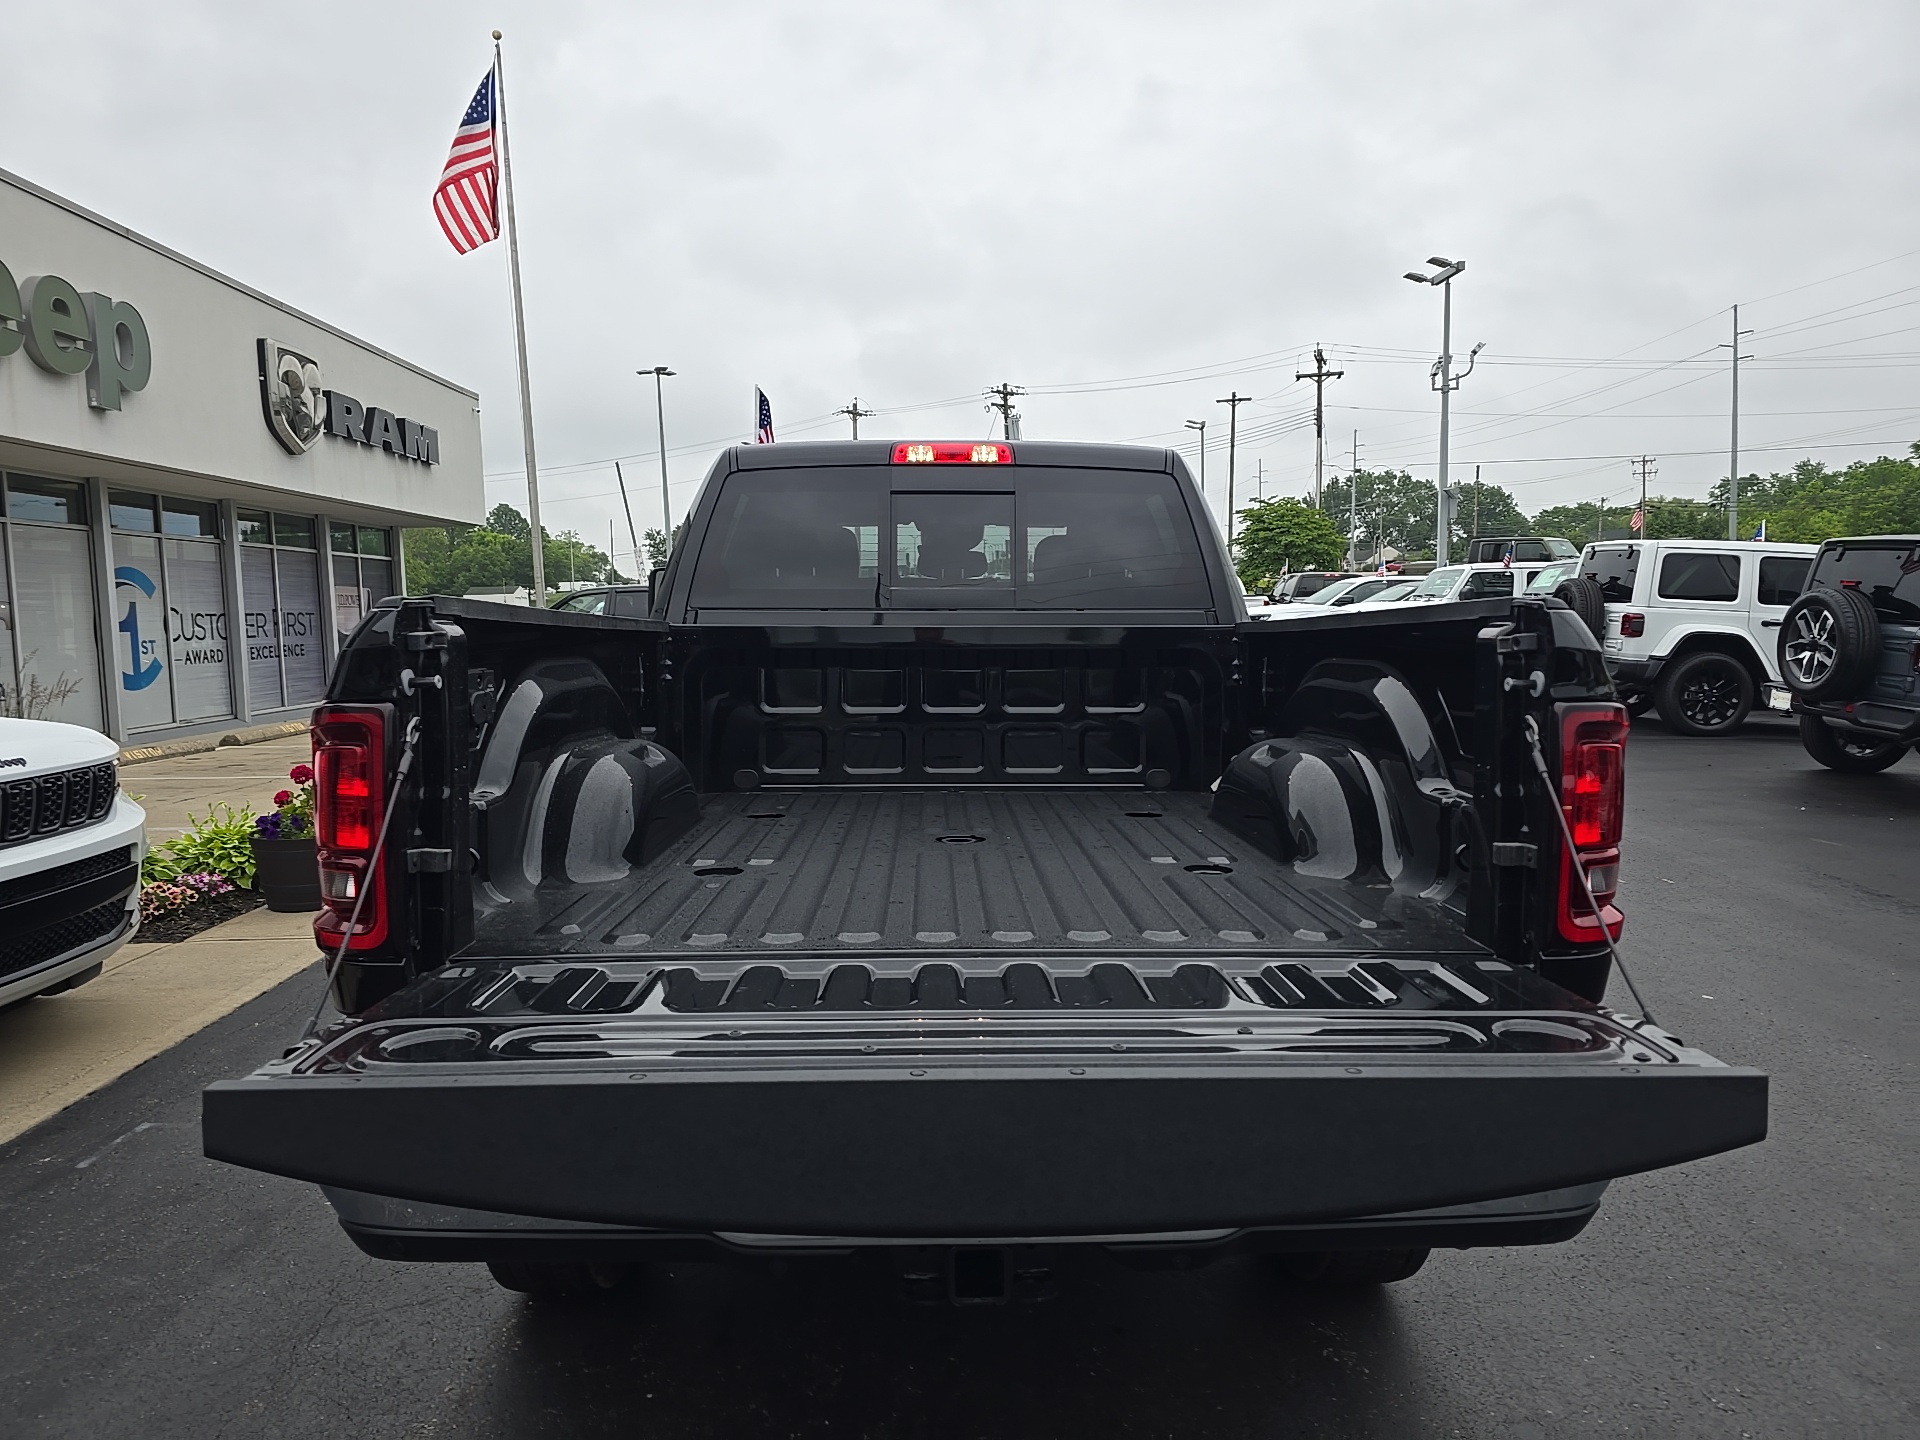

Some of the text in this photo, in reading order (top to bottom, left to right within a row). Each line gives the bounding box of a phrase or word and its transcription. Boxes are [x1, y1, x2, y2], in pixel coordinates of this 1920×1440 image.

[323, 389, 440, 466] RAM
[163, 606, 268, 642] CUSTOER
[185, 643, 306, 665] AWARD EXCELENCE
